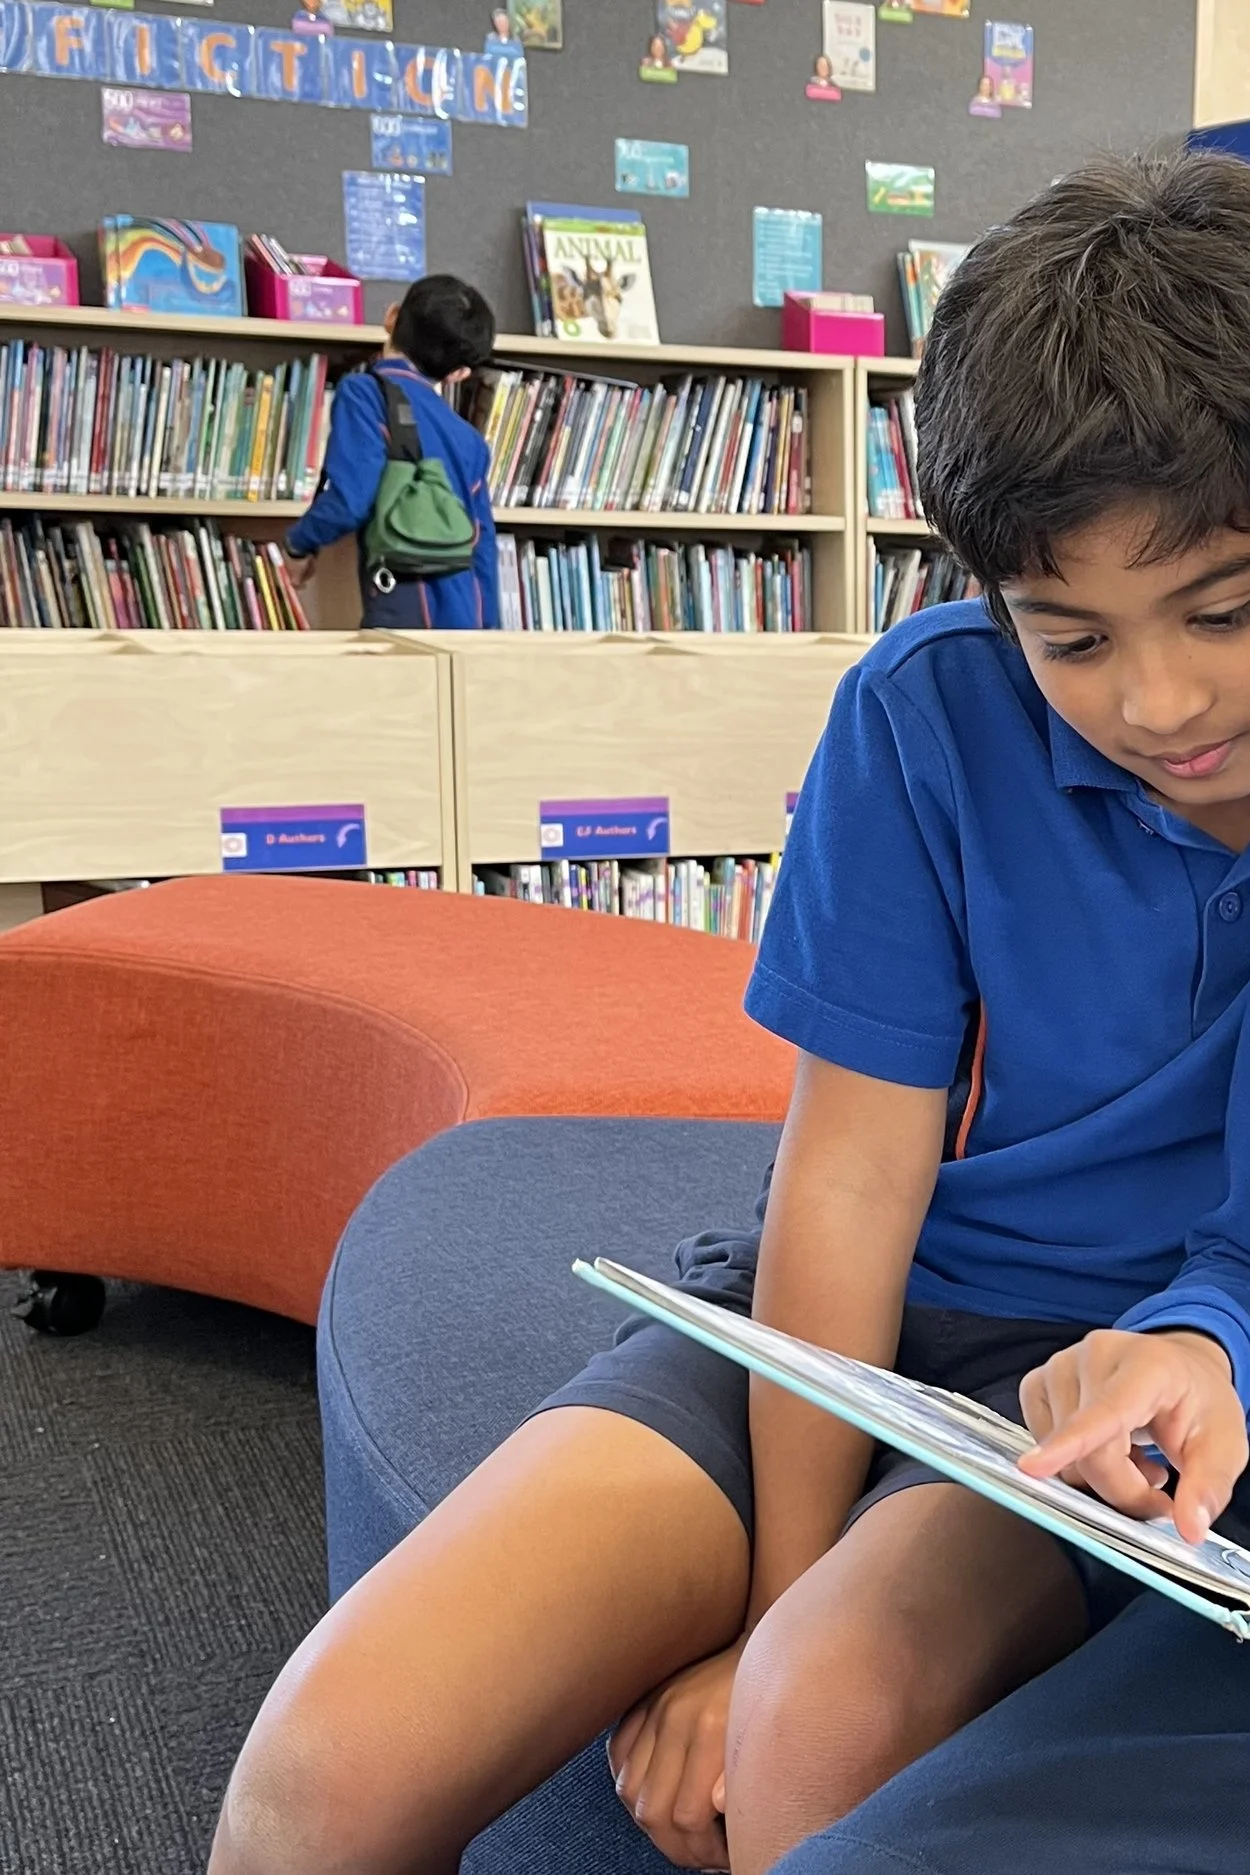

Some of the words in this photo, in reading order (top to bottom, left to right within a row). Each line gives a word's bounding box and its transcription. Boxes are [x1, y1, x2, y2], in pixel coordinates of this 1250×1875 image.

[54, 15, 514, 115] FICTION
[554, 236, 642, 263] ANIMAL
[279, 832, 325, 844] Authors
[595, 825, 637, 836] Authors
